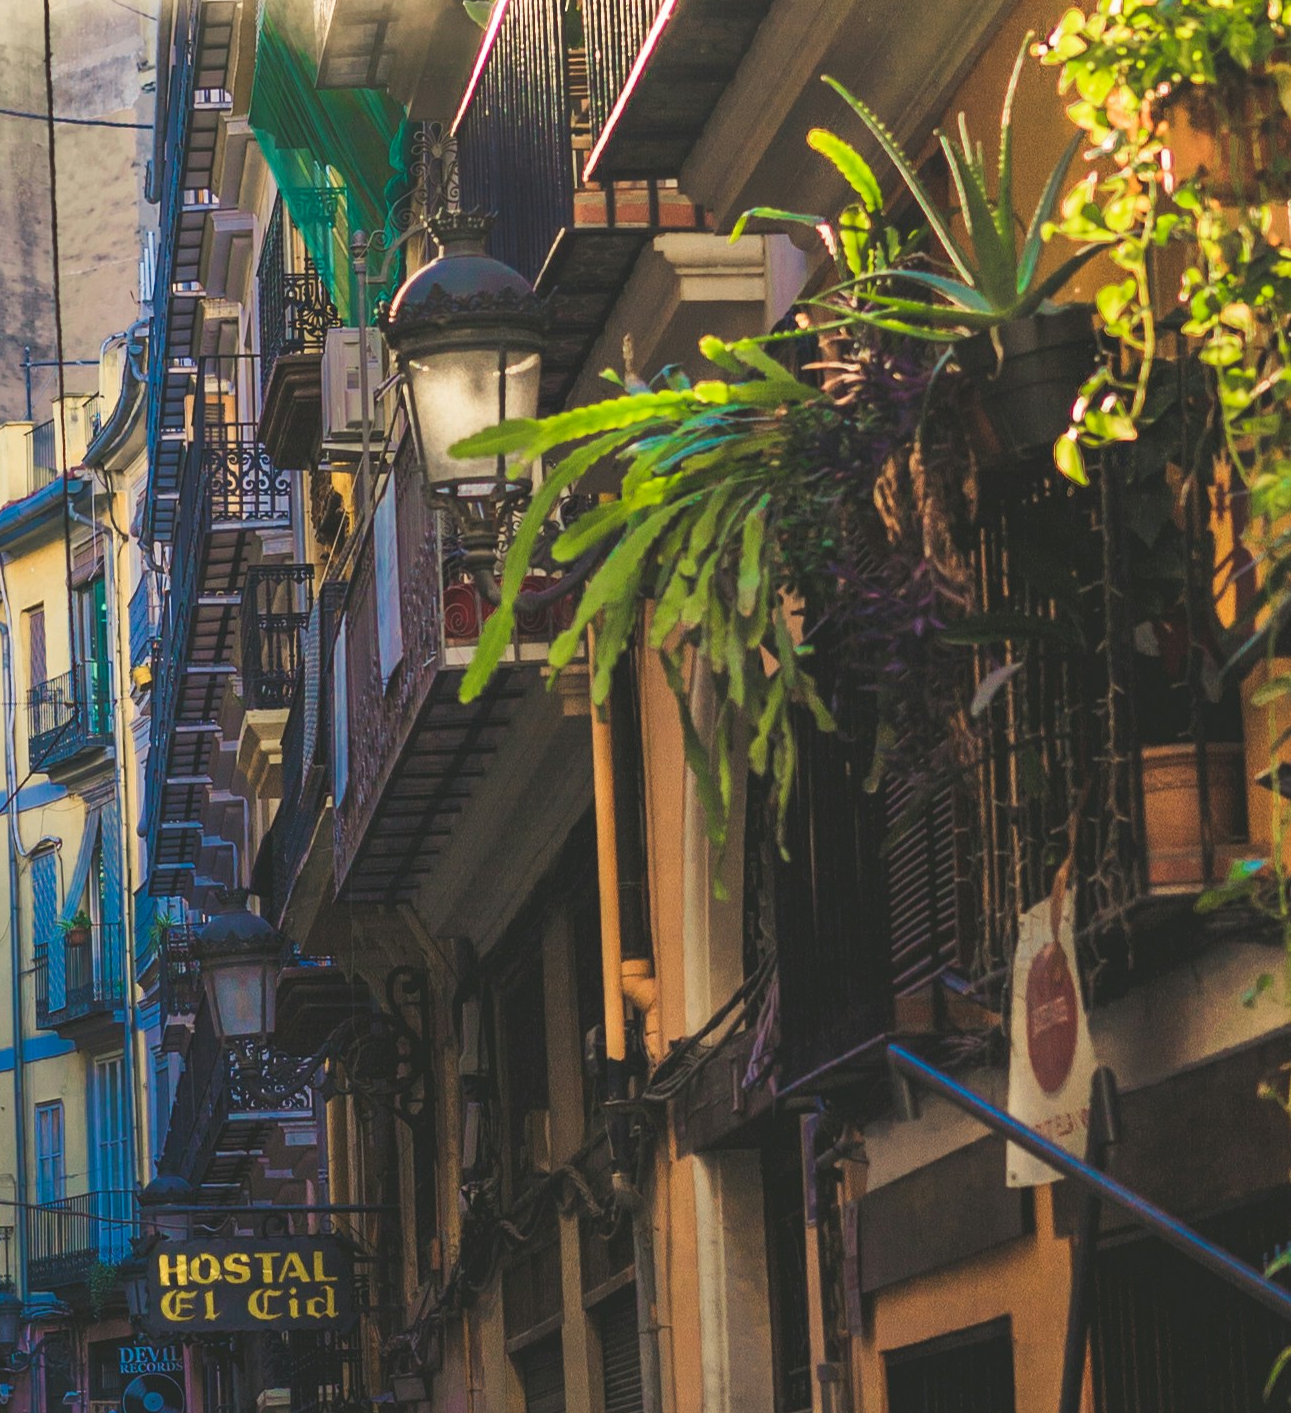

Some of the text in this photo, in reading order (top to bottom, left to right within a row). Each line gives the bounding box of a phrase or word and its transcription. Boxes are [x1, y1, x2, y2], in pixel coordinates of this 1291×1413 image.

[159, 1251, 338, 1287] HOSTAL
[160, 1285, 339, 1322] El Cid
[119, 1345, 183, 1364] DEVIL
[119, 1361, 184, 1374] RECORDS
